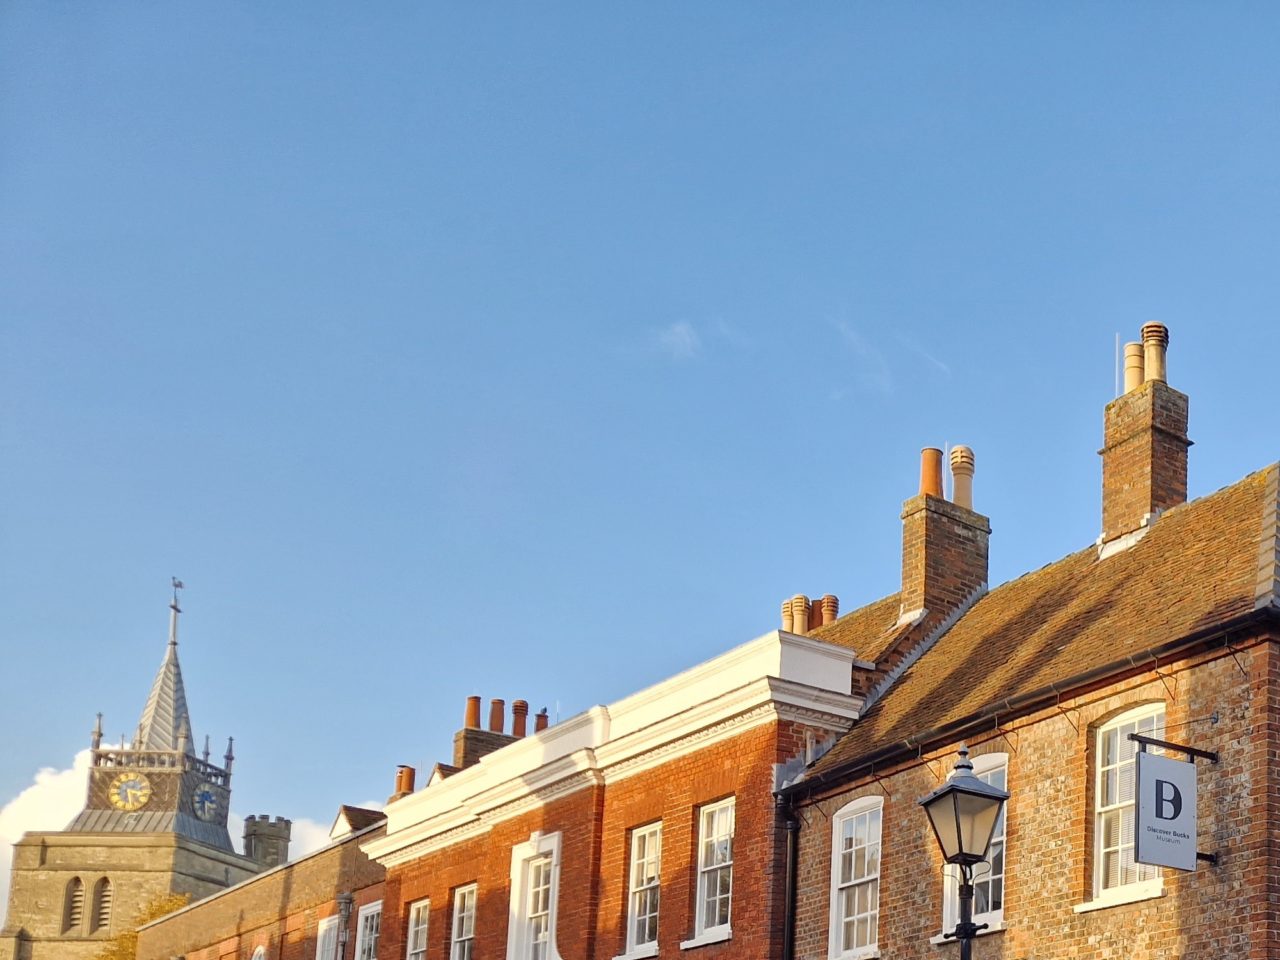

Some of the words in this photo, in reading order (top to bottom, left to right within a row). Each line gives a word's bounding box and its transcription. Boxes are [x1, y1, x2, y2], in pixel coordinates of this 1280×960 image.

[1147, 826, 1171, 836] Discover
[1173, 831, 1190, 839] Bucks
[1156, 835, 1180, 844] Museum
